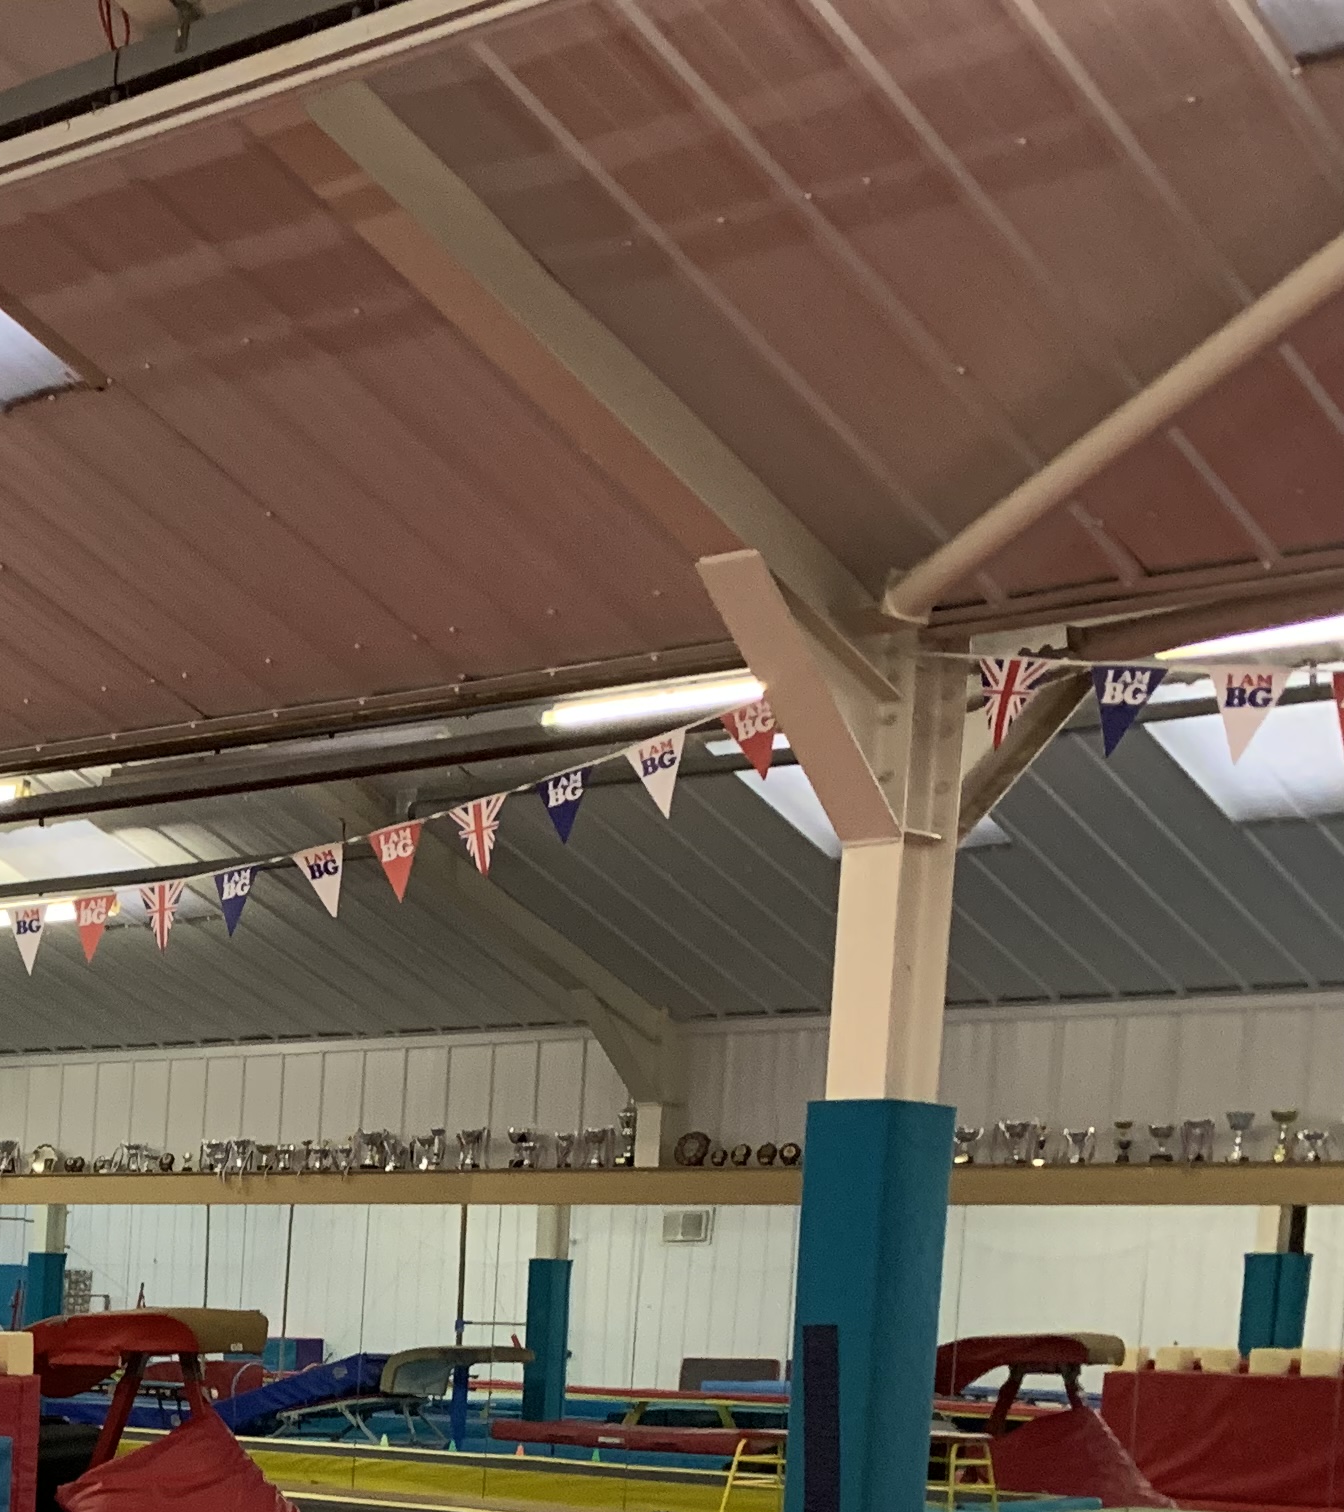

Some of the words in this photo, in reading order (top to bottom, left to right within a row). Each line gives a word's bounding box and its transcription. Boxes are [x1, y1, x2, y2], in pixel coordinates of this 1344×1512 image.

[1106, 669, 1114, 683] I
[1118, 670, 1151, 684] AM
[1227, 673, 1233, 688] I
[1240, 673, 1272, 688] AM
[1101, 681, 1148, 705] BG
[1225, 687, 1273, 707] BG
[742, 700, 771, 717] AM
[736, 714, 775, 741] BG
[650, 739, 672, 755] AM
[642, 750, 677, 777] BG
[556, 771, 582, 788] AM
[548, 785, 583, 808] BG
[387, 827, 412, 843] AM
[314, 850, 334, 862] AM
[380, 839, 414, 862] BG
[230, 869, 251, 883] AM
[308, 858, 339, 880] BG
[222, 881, 251, 900] BG
[79, 908, 106, 926] BG
[16, 918, 41, 934] BG
